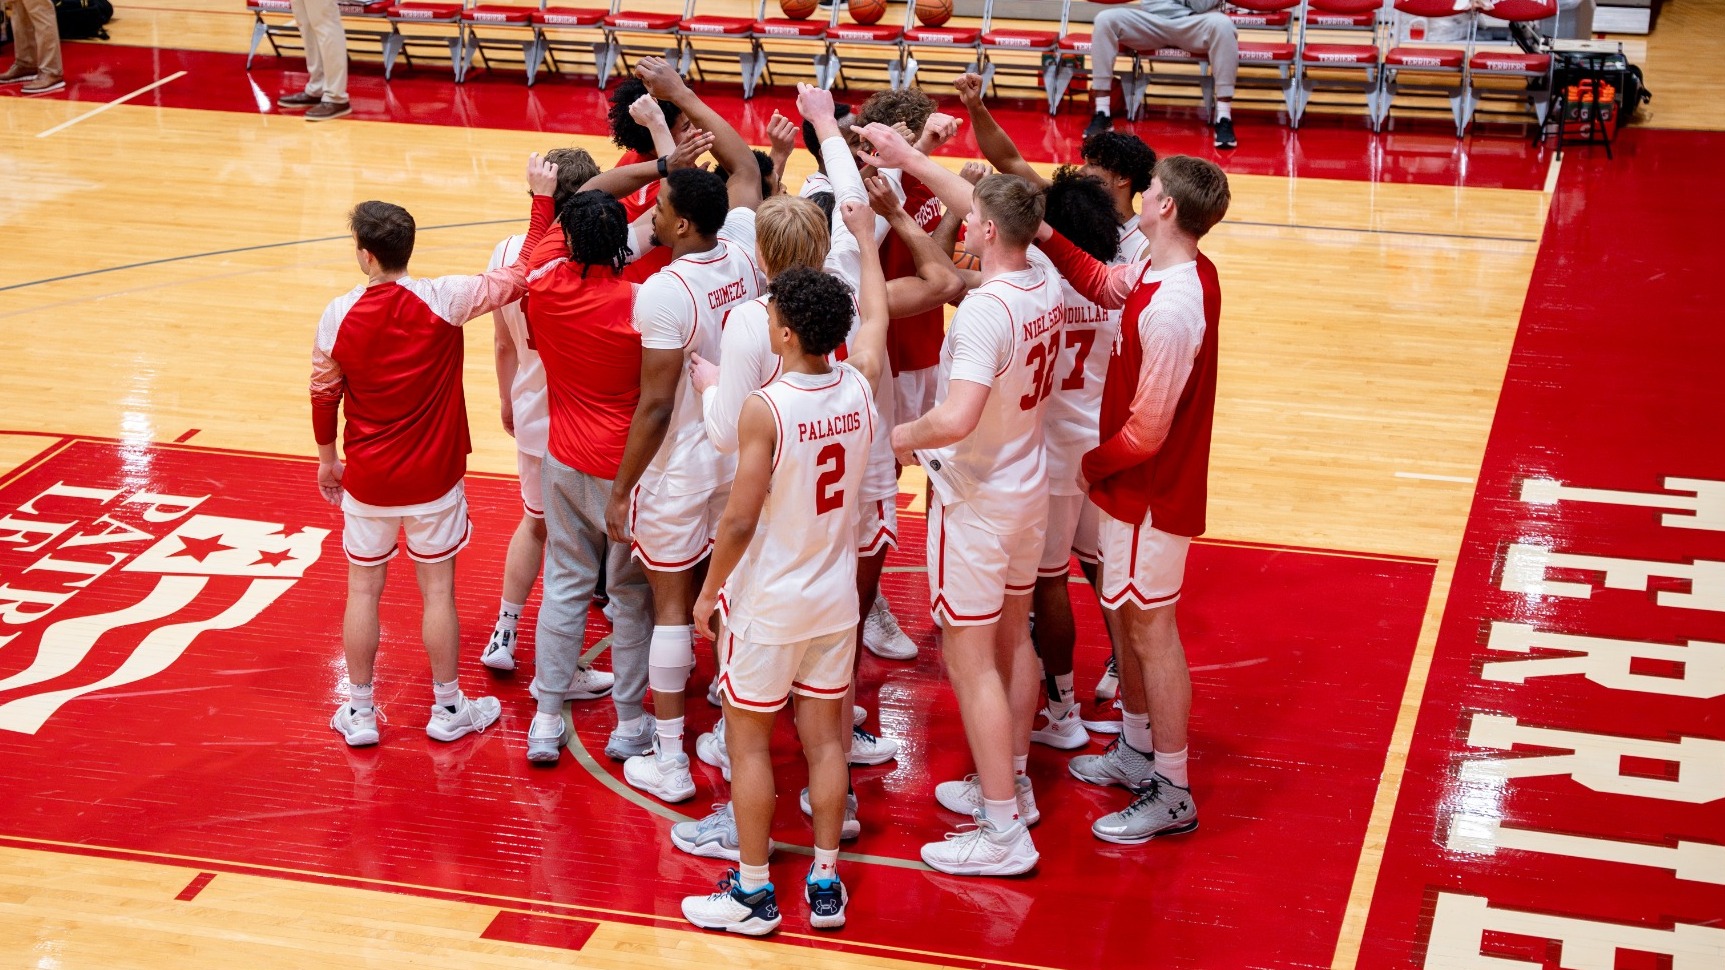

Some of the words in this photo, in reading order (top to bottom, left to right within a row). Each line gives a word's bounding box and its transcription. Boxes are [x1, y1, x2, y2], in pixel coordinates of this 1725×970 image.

[615, 19, 649, 29] TERRIERS
[1317, 17, 1354, 26] TERRIERS
[690, 24, 725, 34] TERRIERS
[765, 26, 800, 36] TERRIERS
[838, 31, 874, 41] TERRIERS
[918, 34, 954, 43] TERRIERS
[995, 37, 1031, 47] TERRIERS
[1319, 53, 1357, 63] TERRIERS
[1402, 57, 1441, 67] TERRIERS
[1486, 61, 1526, 71] TERRIERS
[708, 277, 747, 310] CHIMEZE
[1064, 304, 1109, 325] DULLAH
[1061, 329, 1097, 391] 7
[1020, 329, 1060, 411] 32
[798, 412, 861, 442] PALACIOS
[816, 442, 846, 516] 2
[0, 488, 212, 649] PATR
